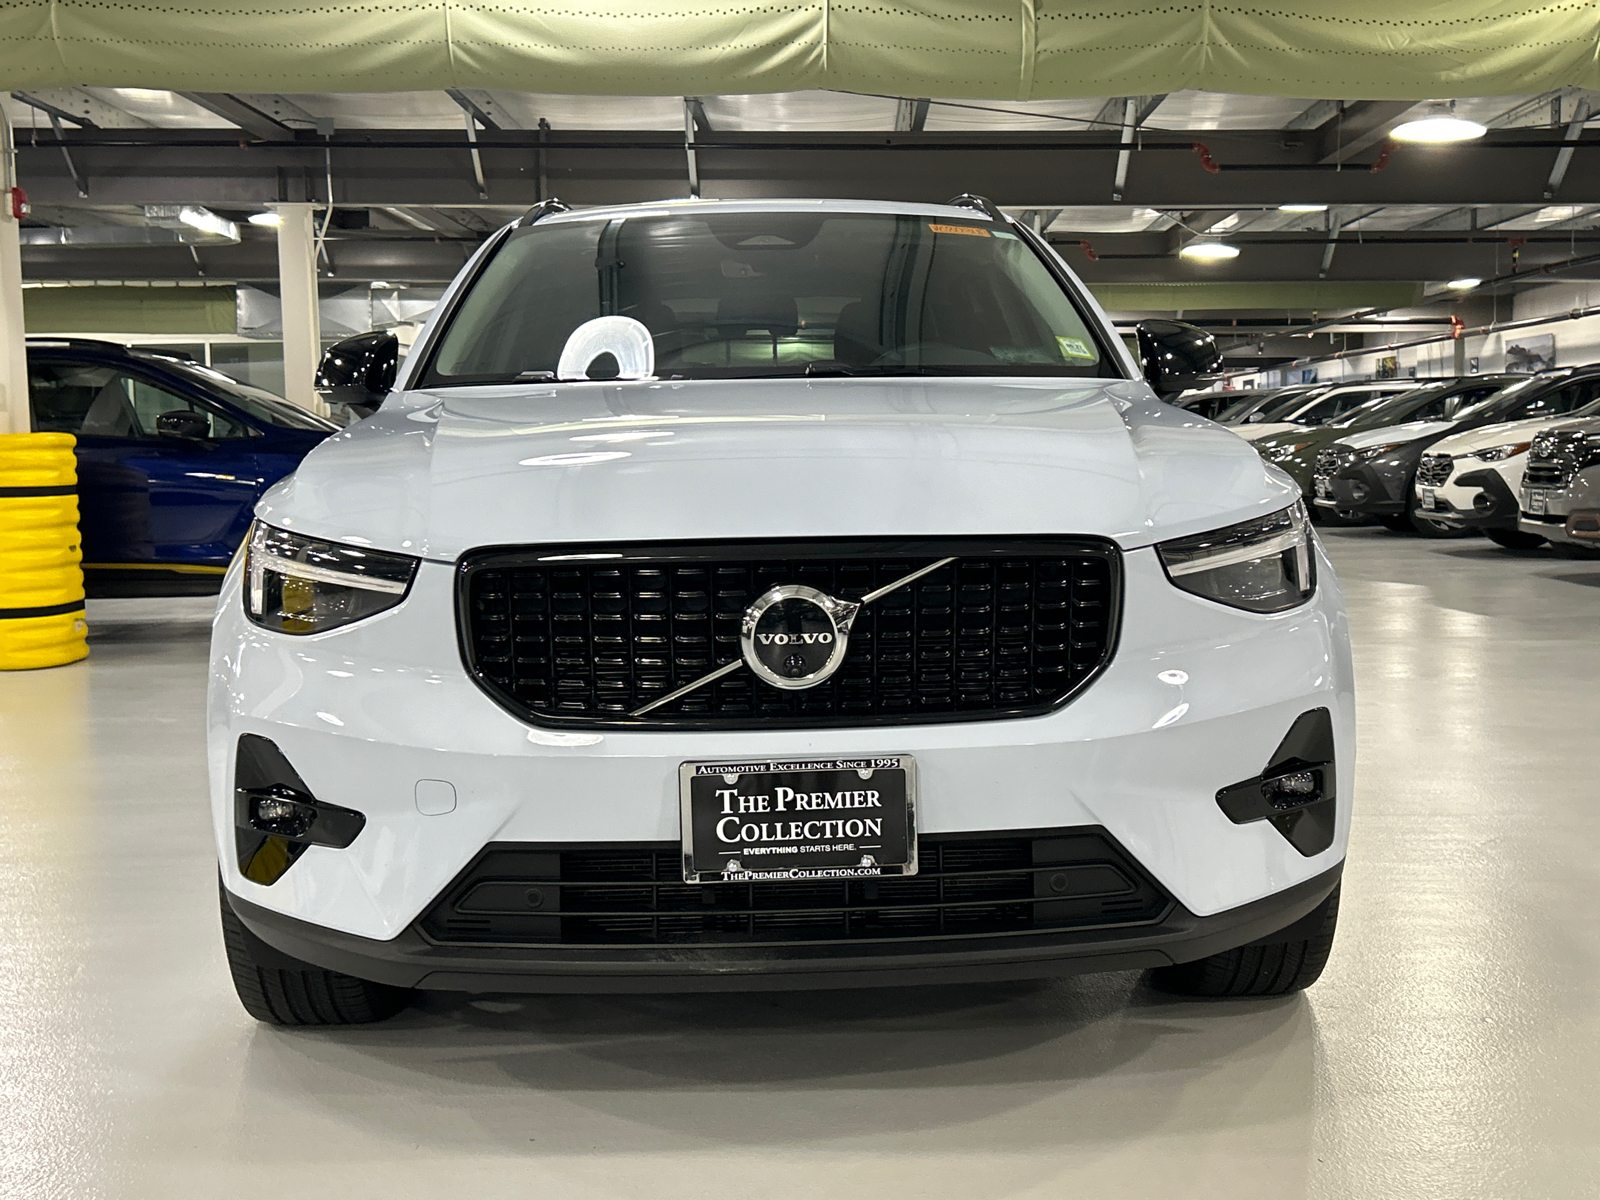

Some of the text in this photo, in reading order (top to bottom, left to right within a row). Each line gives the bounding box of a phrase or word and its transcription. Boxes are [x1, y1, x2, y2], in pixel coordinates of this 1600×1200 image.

[756, 632, 833, 645] VOLVO
[870, 758, 899, 768] 1995
[743, 843, 857, 856] EVERYTHING STARTS HERE.
